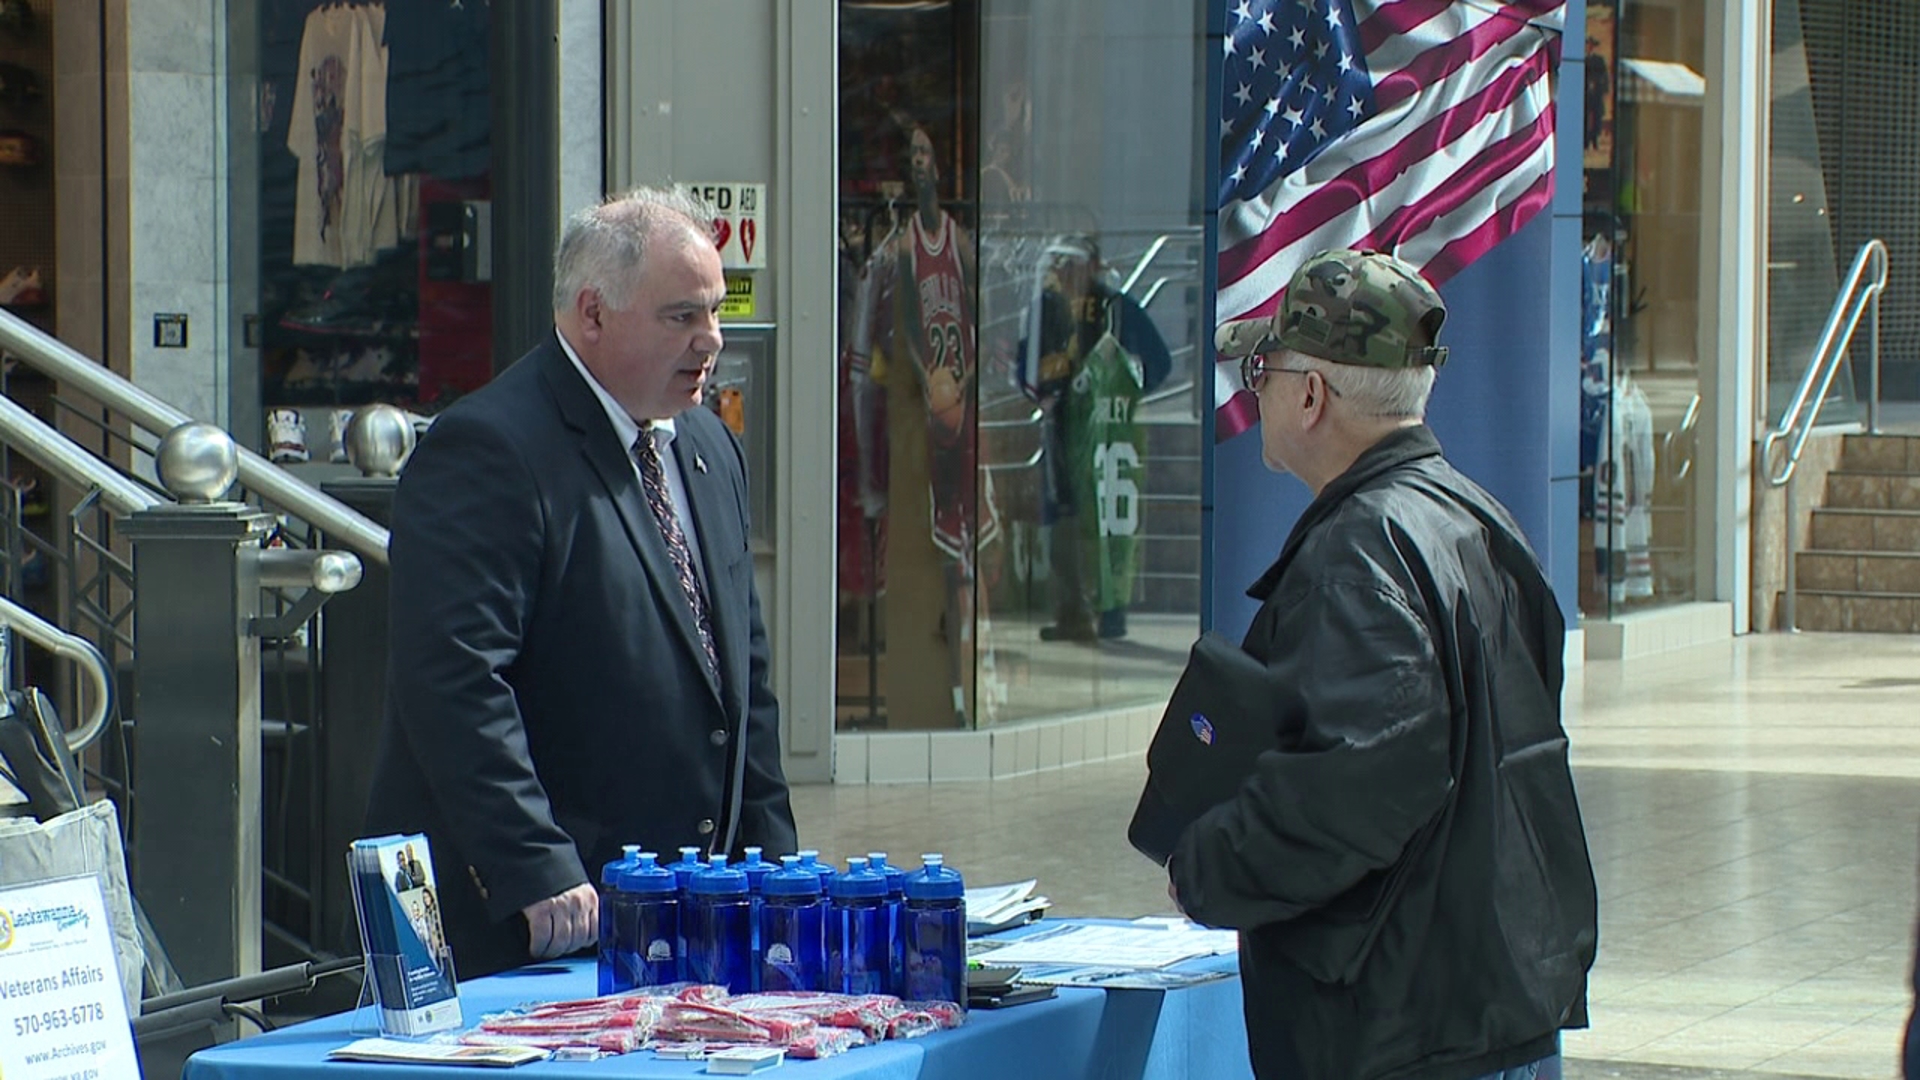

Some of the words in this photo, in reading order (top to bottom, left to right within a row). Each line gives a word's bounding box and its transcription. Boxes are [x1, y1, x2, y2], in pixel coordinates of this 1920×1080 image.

[739, 187, 757, 211] AED
[919, 273, 962, 329] BULLS
[929, 322, 966, 382] 23
[0, 975, 59, 1000] Veterans
[61, 964, 104, 989] Affairs
[14, 1002, 104, 1037] 570-963-6778
[24, 1040, 107, 1066] www.Archives.gov
